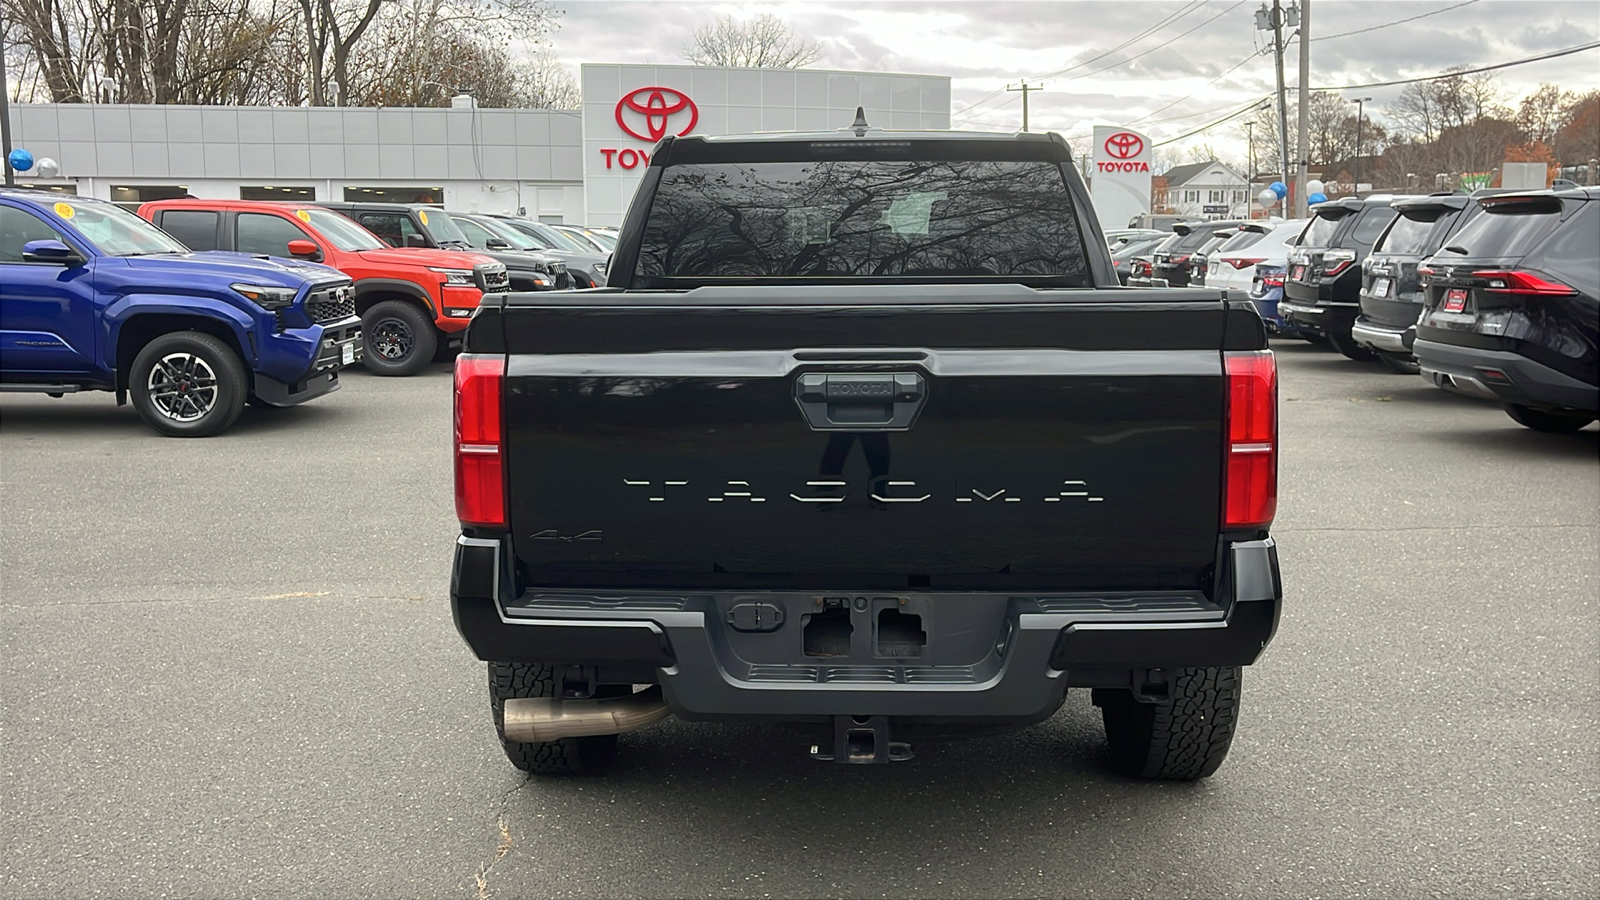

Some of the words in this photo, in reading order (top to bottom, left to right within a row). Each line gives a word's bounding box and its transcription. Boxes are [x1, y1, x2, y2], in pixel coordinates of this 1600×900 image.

[600, 148, 652, 170] TOY
[1097, 162, 1149, 173] TOYOTA
[830, 384, 891, 395] TOYOTA
[623, 478, 1104, 503] TACOMA
